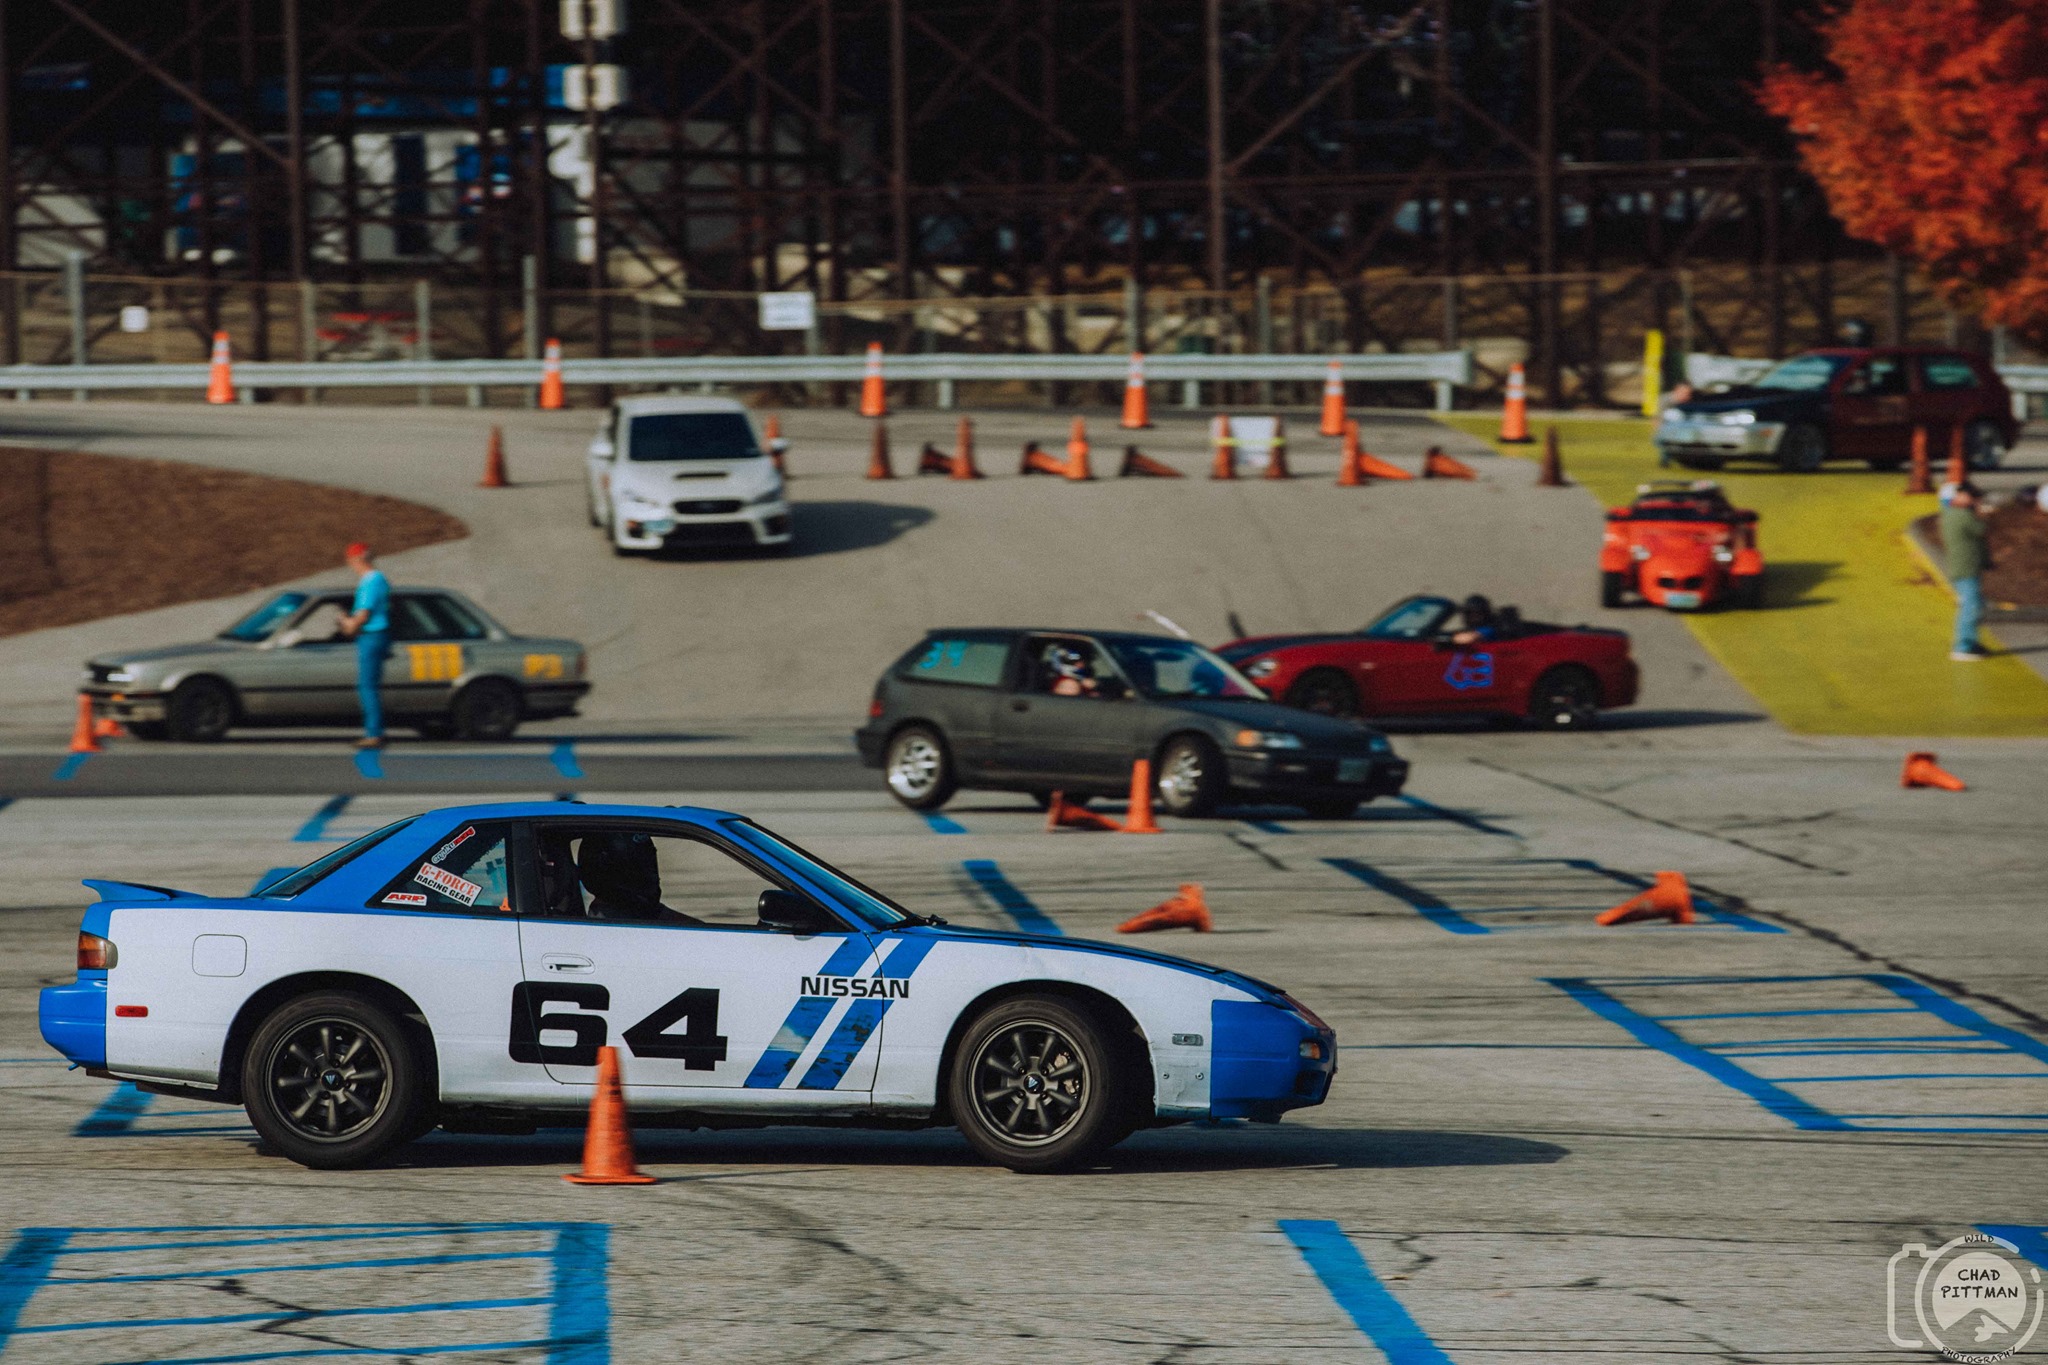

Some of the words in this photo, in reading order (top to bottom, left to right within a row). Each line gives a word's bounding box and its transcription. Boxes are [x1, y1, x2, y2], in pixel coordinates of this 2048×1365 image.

[416, 874, 448, 893] RACING
[448, 888, 471, 904] GEAR
[420, 864, 477, 896] G-FORCE
[387, 893, 425, 902] ARP
[801, 976, 909, 998] NISSAN
[508, 980, 728, 1071] 64
